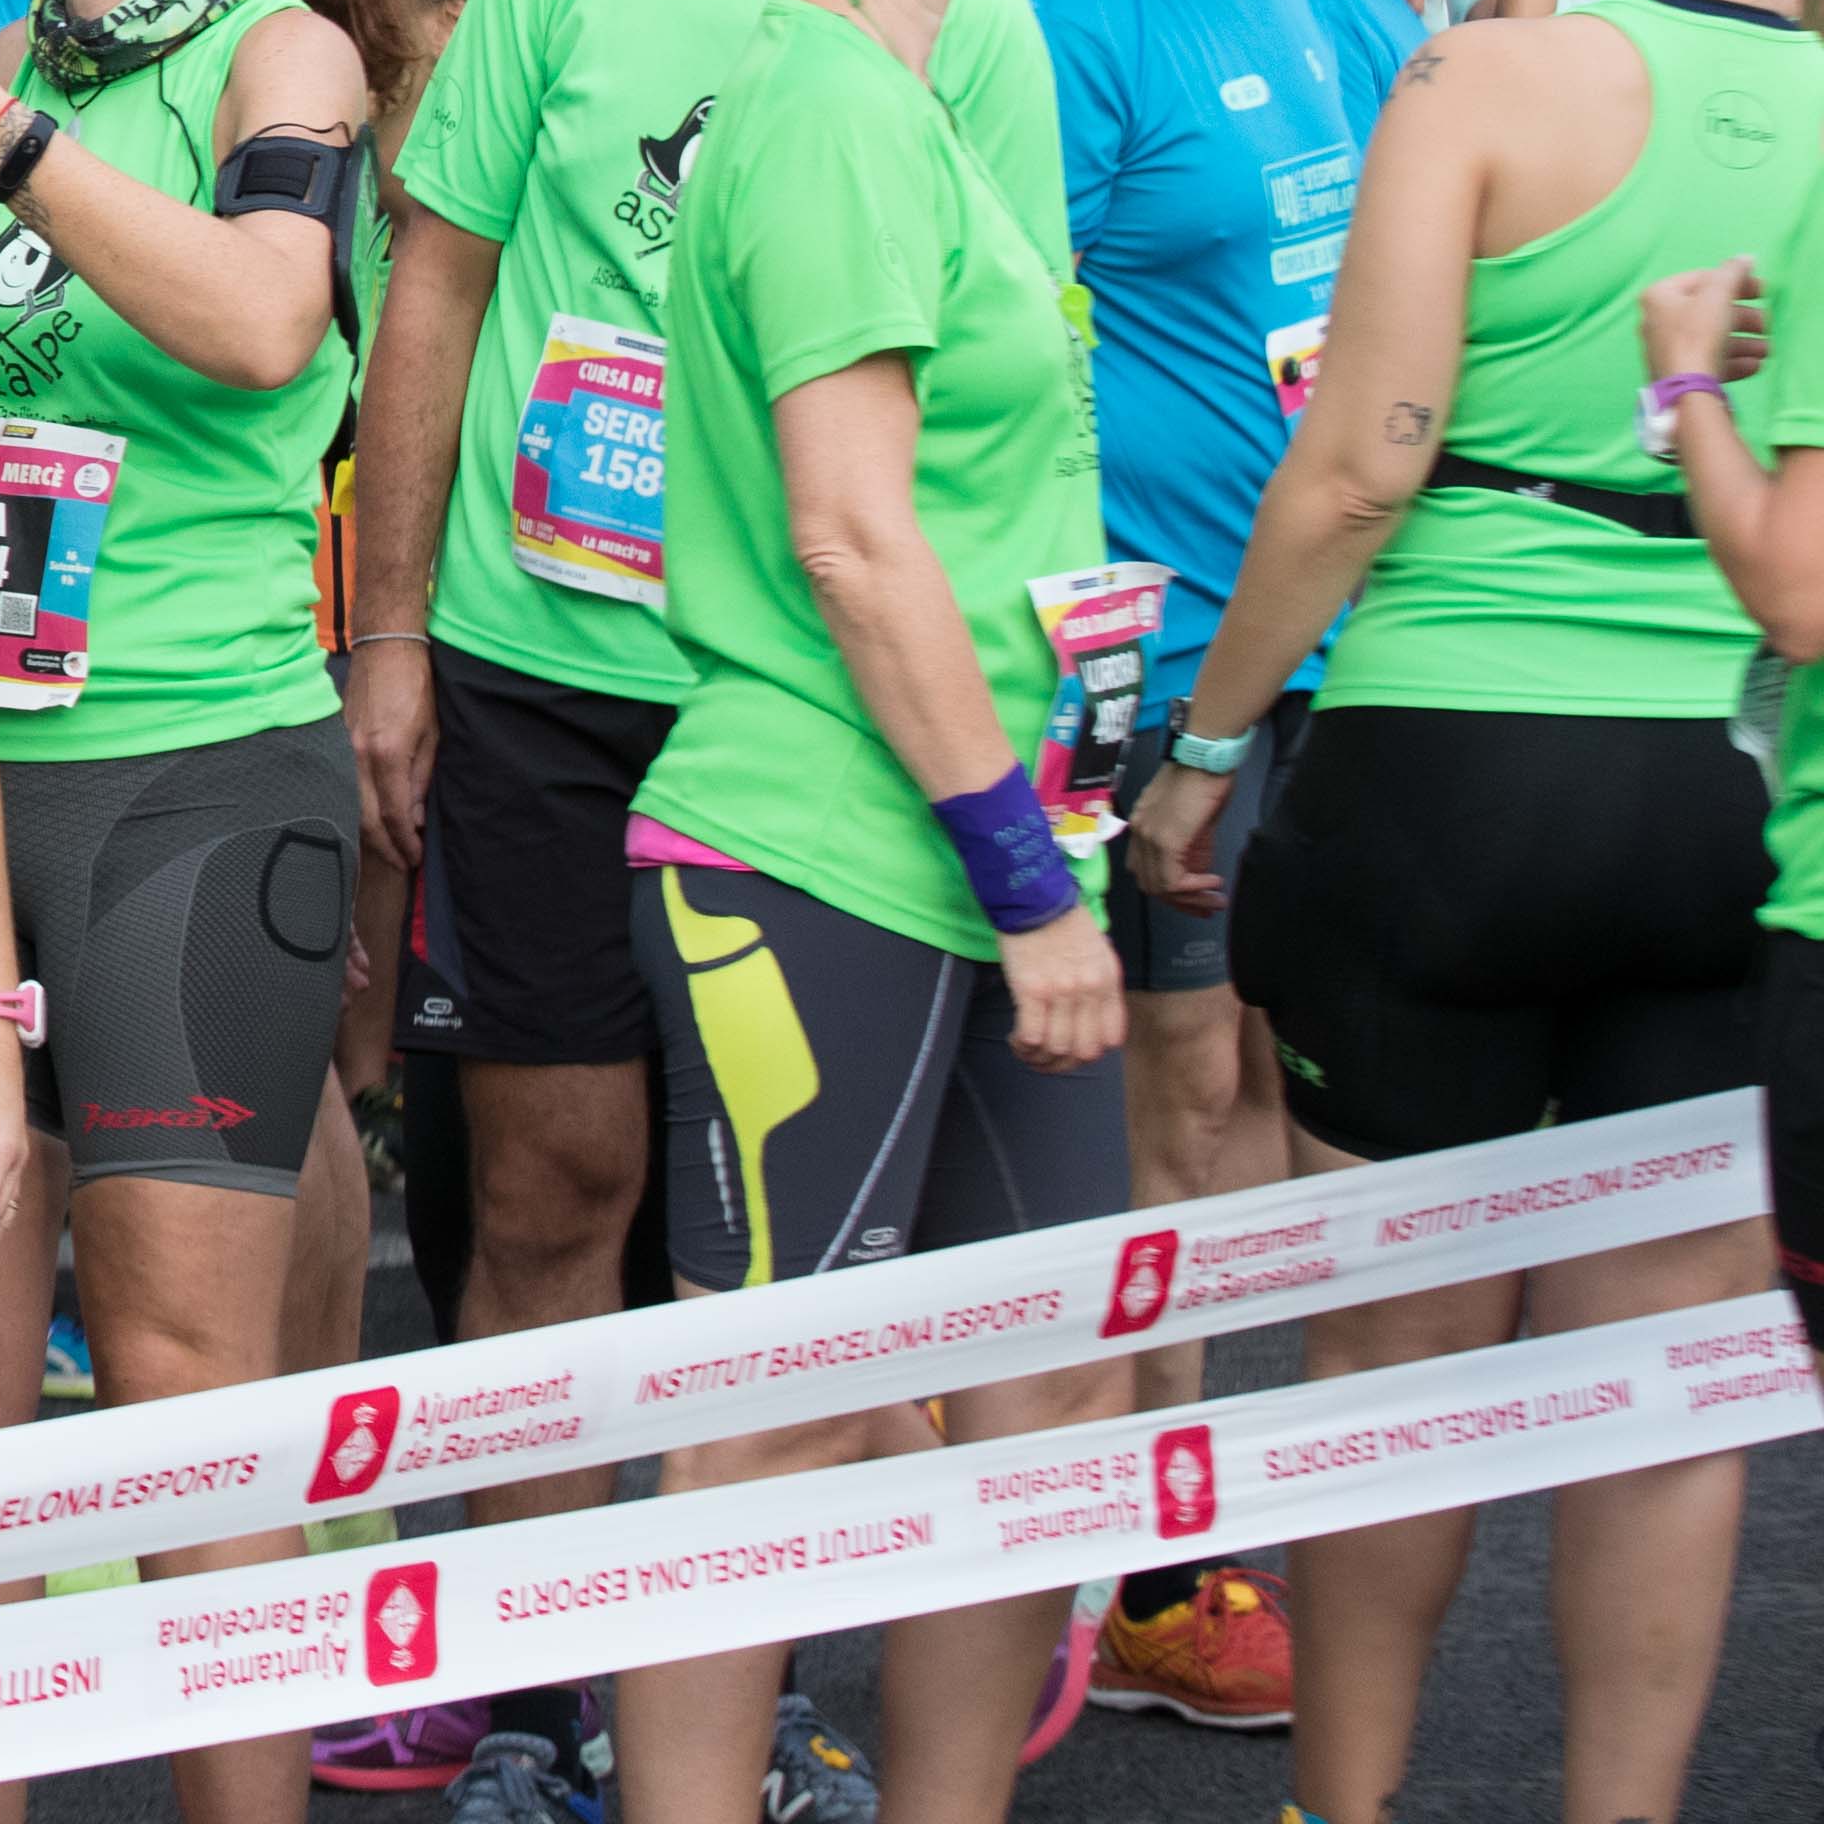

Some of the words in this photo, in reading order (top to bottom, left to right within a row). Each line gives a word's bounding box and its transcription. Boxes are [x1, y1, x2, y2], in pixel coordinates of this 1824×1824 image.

[614, 191, 674, 240] as
[32, 310, 83, 379] pe
[578, 361, 629, 390] CURSA
[632, 373, 656, 397] DE
[1, 461, 65, 488] MERCÈ
[579, 444, 666, 498] 158
[1376, 1199, 1483, 1247] INSTITUT
[1484, 1172, 1624, 1225] BARCELONA
[1629, 1141, 1736, 1189] ESPORTS
[1189, 1215, 1328, 1271] Ajuntament
[635, 1349, 765, 1405] INSTITUT
[766, 1316, 934, 1378] BARCELONA
[940, 1290, 1065, 1343] ESPORTS
[408, 1367, 575, 1432] Ajuntament
[1534, 1379, 1636, 1428] INSTITUT
[395, 1440, 433, 1473] de
[434, 1414, 583, 1468] Barcelona
[1264, 1429, 1379, 1482] ESPORTS
[1386, 1400, 1528, 1458] BARCELONA
[110, 1453, 261, 1509] ESPORTS
[639, 1534, 808, 1596] BARCELONA
[816, 1512, 935, 1565] INSTITUT
[315, 1590, 351, 1623] de
[496, 1566, 629, 1622] ESPORTS
[157, 1598, 308, 1649] Barcelona
[180, 1633, 350, 1700] Ajuntament
